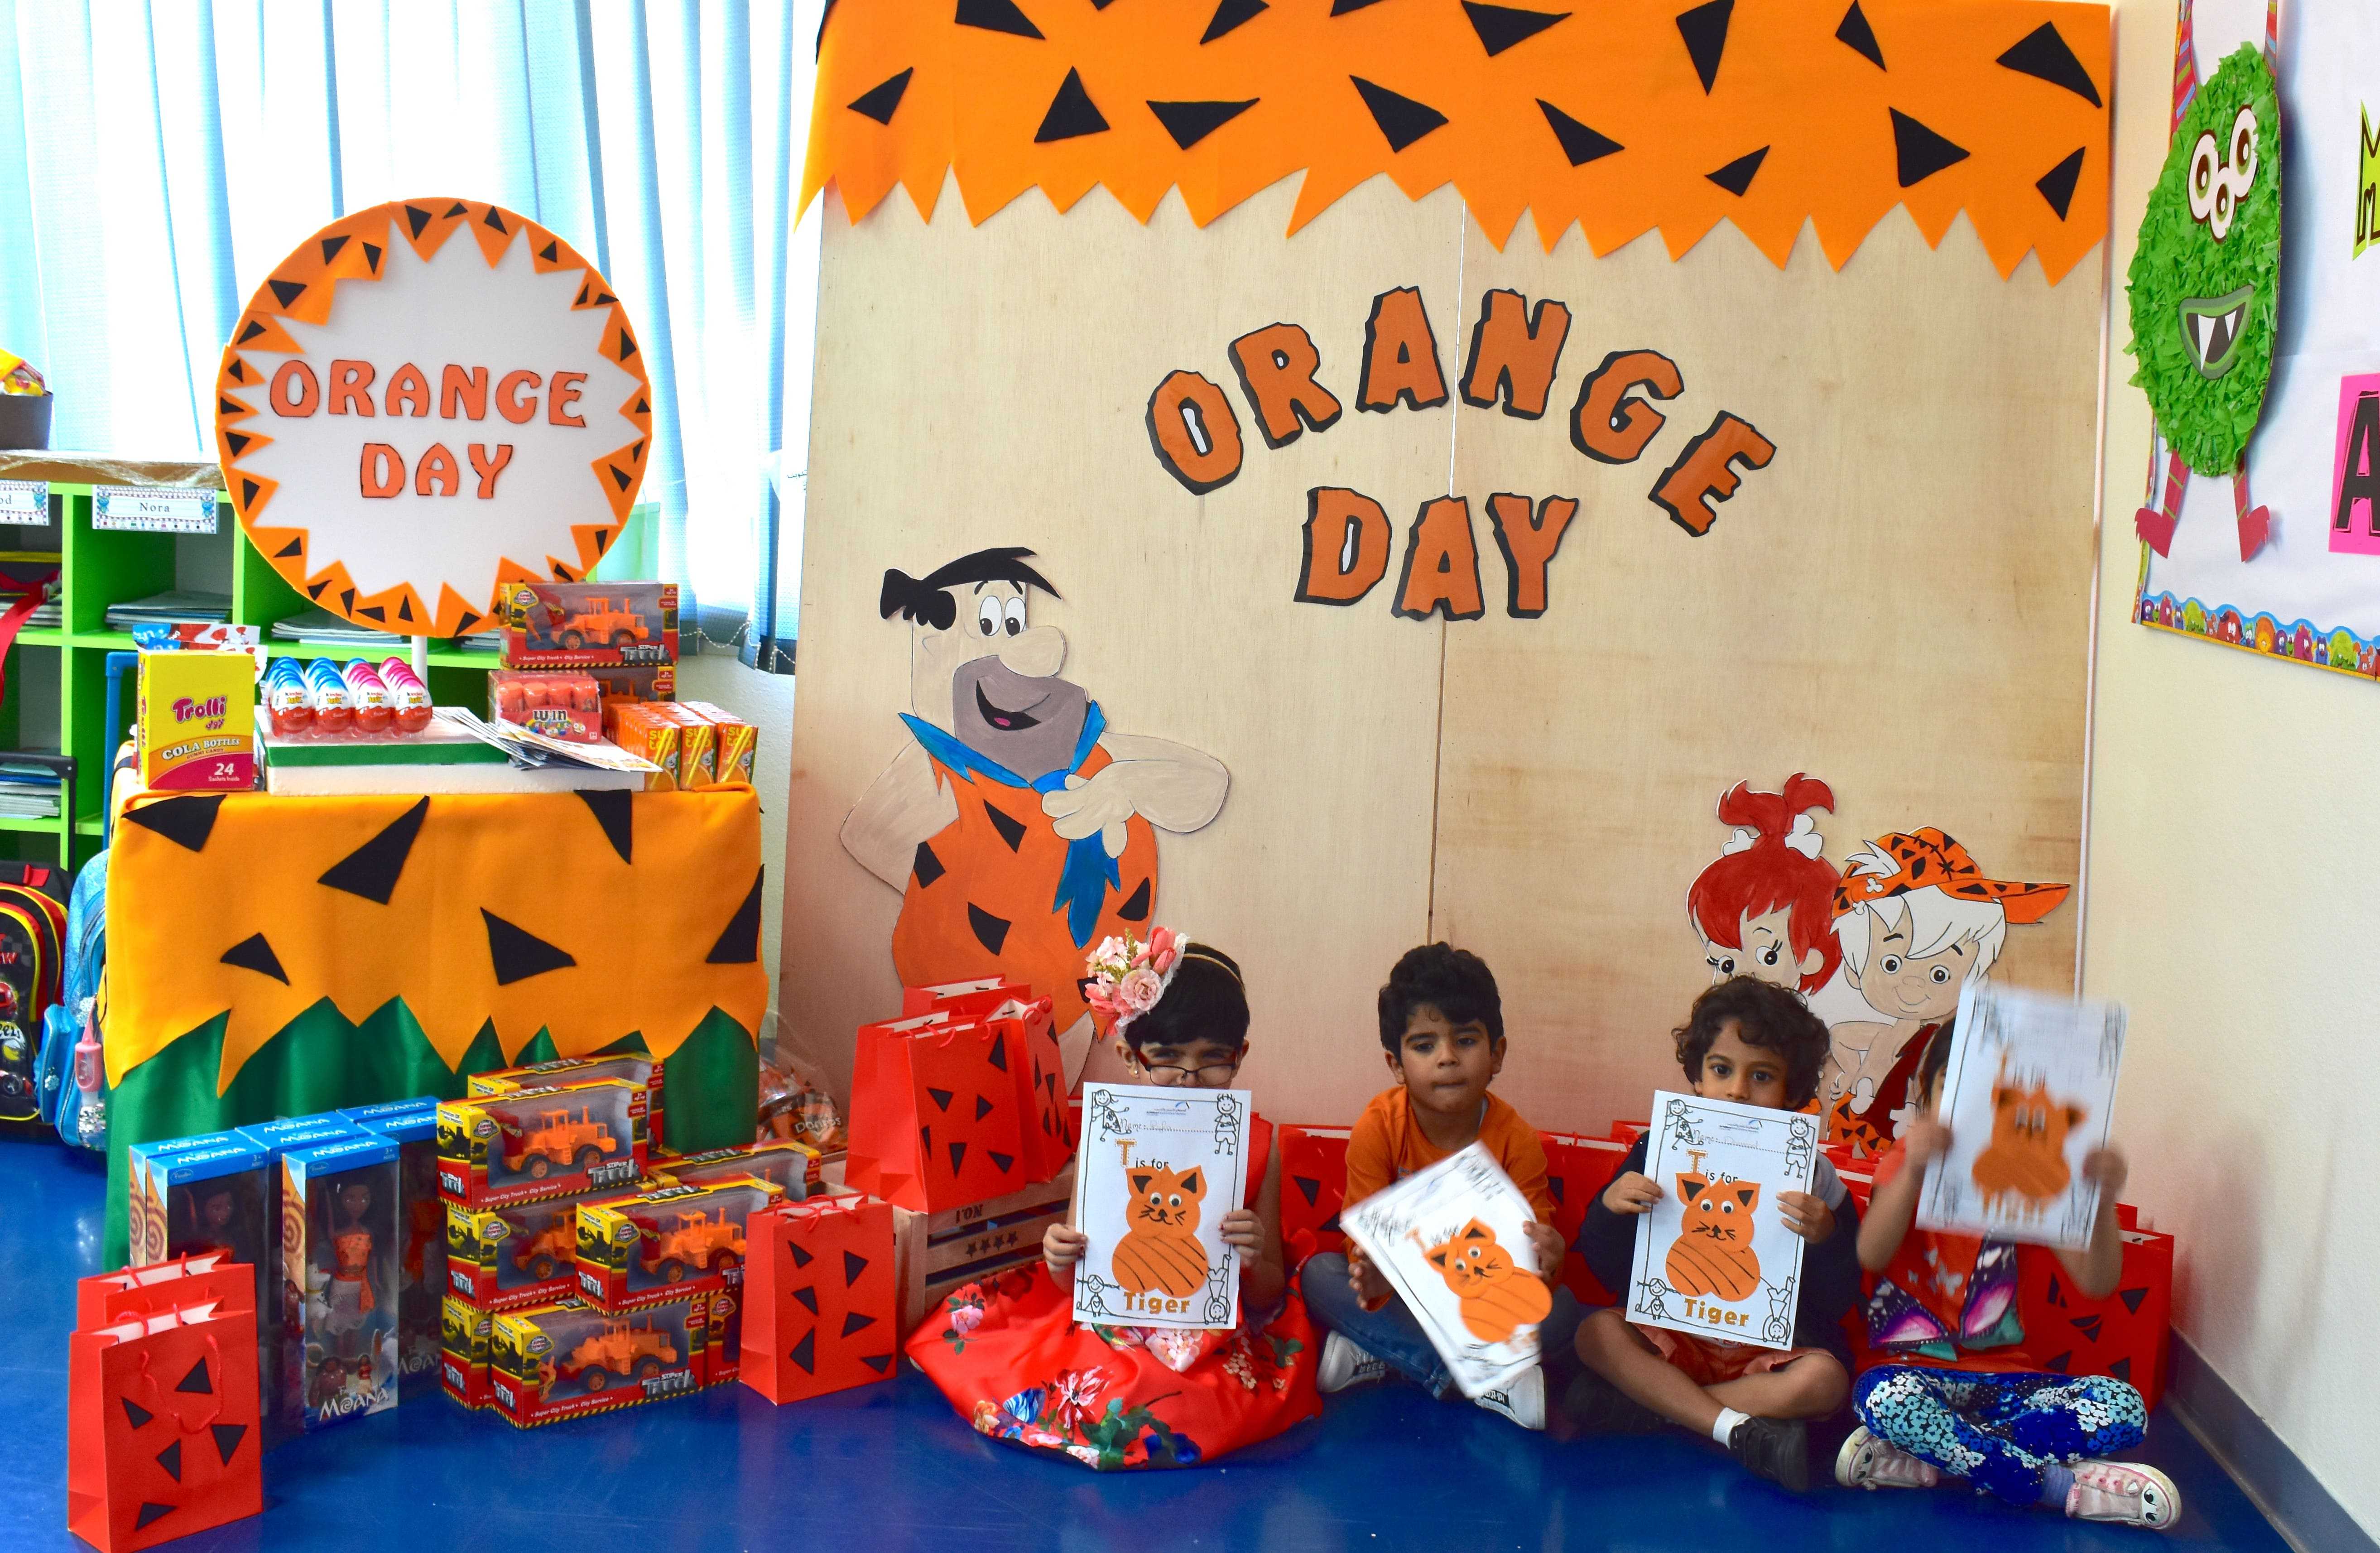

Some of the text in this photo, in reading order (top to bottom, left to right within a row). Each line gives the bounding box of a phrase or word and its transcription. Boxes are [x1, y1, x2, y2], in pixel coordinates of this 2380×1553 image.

[270, 360, 588, 428] ORANGE
[1144, 285, 1777, 538] ORANGE
[360, 442, 513, 499] DAY
[139, 502, 170, 513] Nora
[1293, 486, 1579, 621] DAY
[172, 696, 226, 723] Trolli
[162, 738, 240, 760] COLA BOTTLES
[214, 763, 235, 776] 24
[364, 1102, 427, 1115] MOANA
[264, 1118, 331, 1134] MOANA
[280, 1130, 348, 1144] MOANA
[159, 1136, 229, 1152] MOANA
[177, 1147, 247, 1164] MOANA
[313, 1141, 378, 1157] MOANA
[1115, 1139, 1168, 1169] T is for
[1687, 1149, 1738, 1183] T is for
[1124, 1291, 1190, 1314] Tiger
[1685, 1298, 1750, 1327] Tiger
[319, 1387, 389, 1421] MOANA
